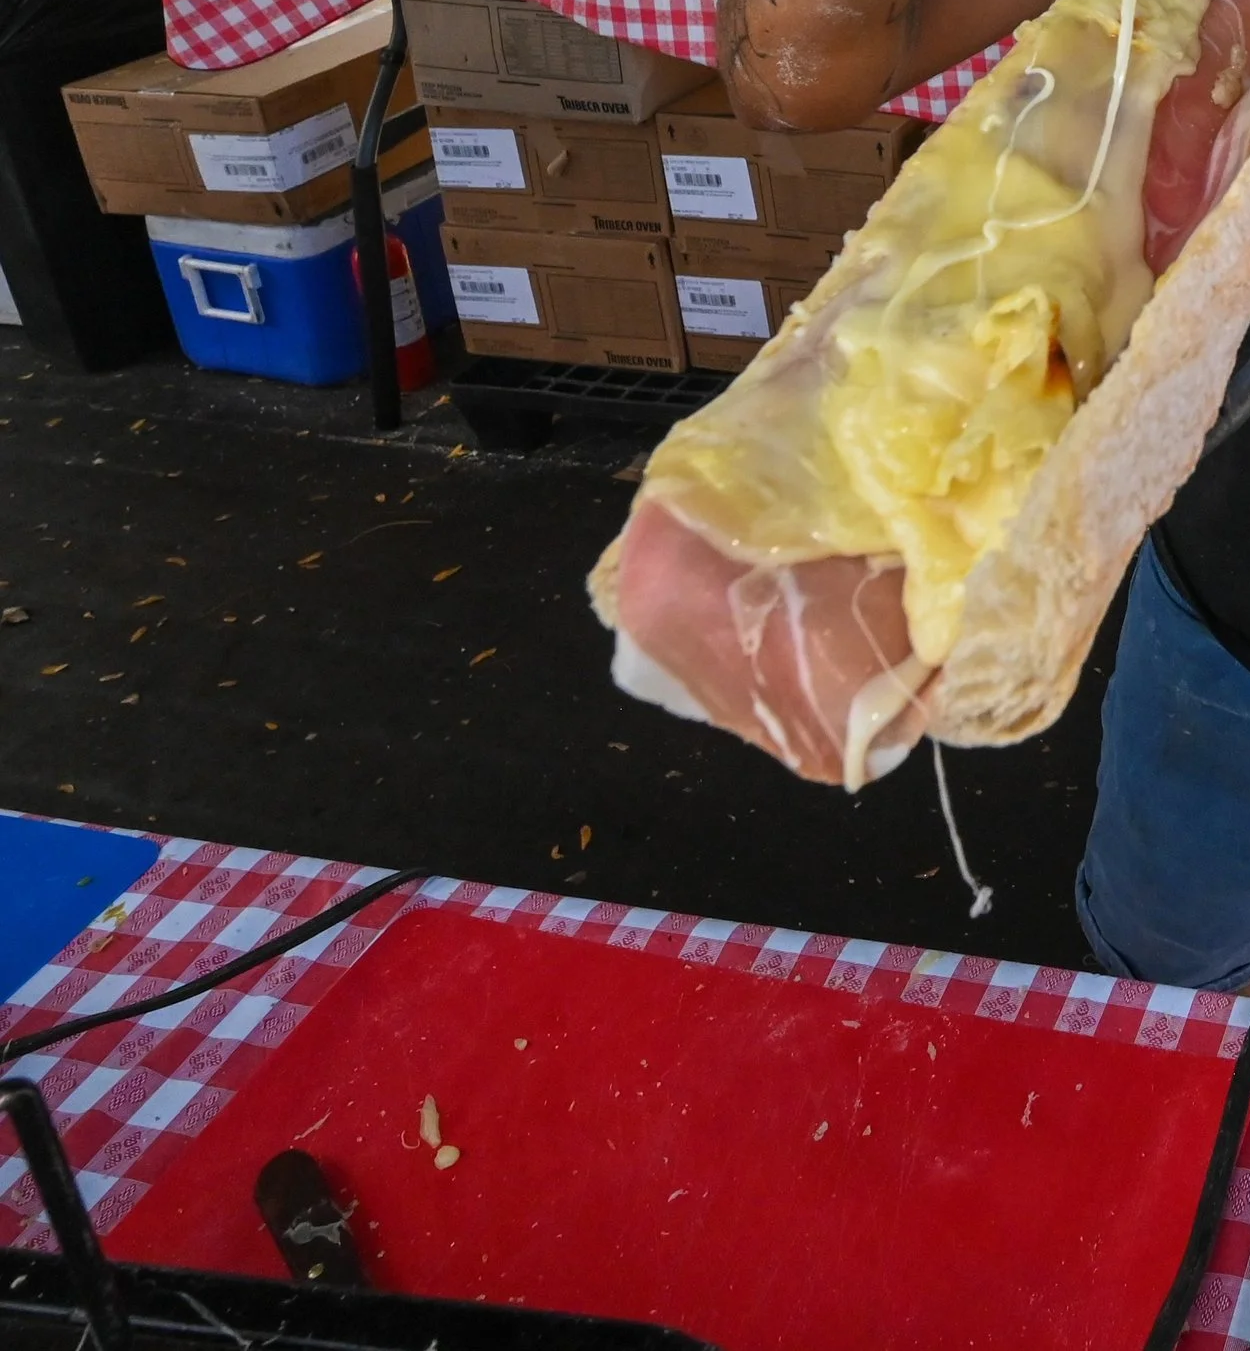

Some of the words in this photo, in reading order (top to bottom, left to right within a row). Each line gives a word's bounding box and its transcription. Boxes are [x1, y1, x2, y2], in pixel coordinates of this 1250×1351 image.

[557, 95, 600, 113] TRIBECA
[602, 102, 631, 114] OVEN
[591, 216, 633, 231] TRIBECA
[635, 221, 662, 233] OVEN
[603, 350, 644, 366] TRIBECA
[646, 357, 672, 368] OVEN
